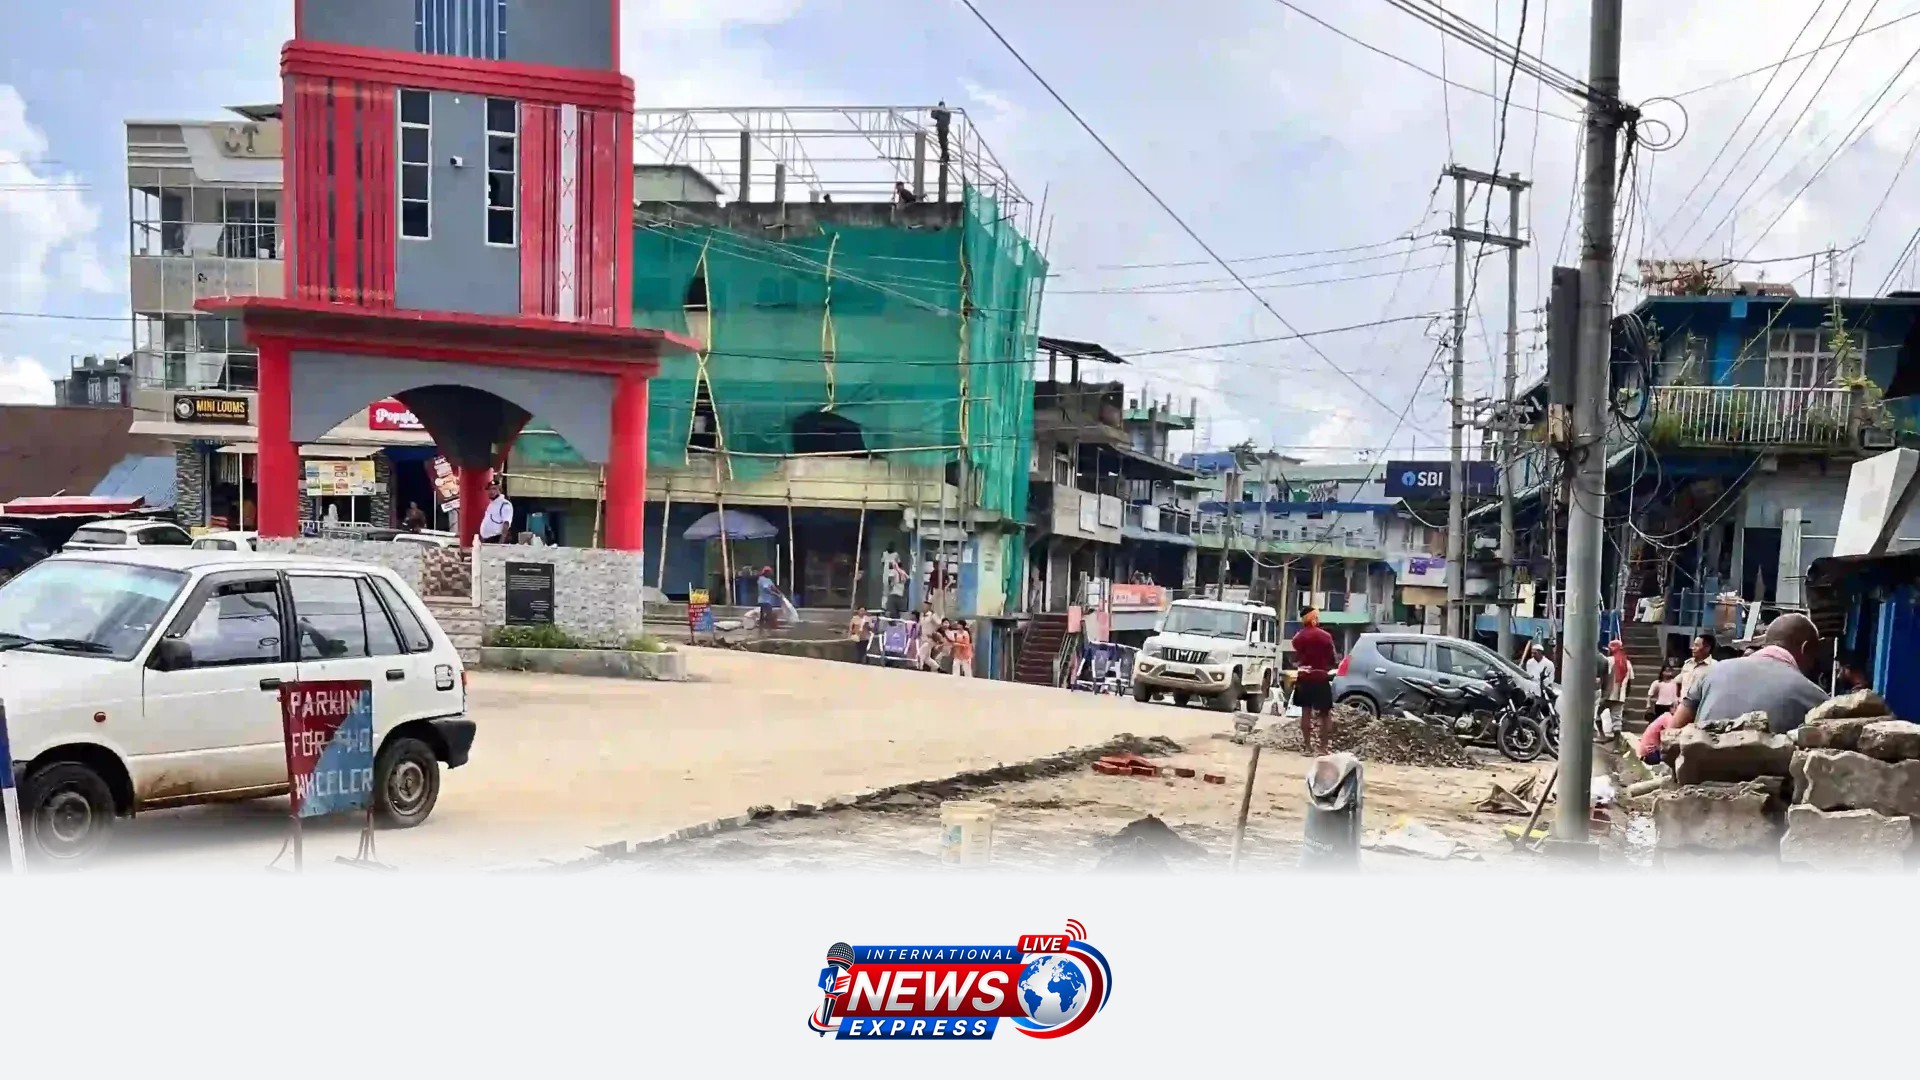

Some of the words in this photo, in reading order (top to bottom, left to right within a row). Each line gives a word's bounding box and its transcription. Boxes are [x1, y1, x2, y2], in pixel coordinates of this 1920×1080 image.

[196, 400, 215, 412] MINI
[217, 401, 245, 413] LOOMS
[1417, 471, 1443, 487] SBI
[292, 731, 325, 757] FOR
